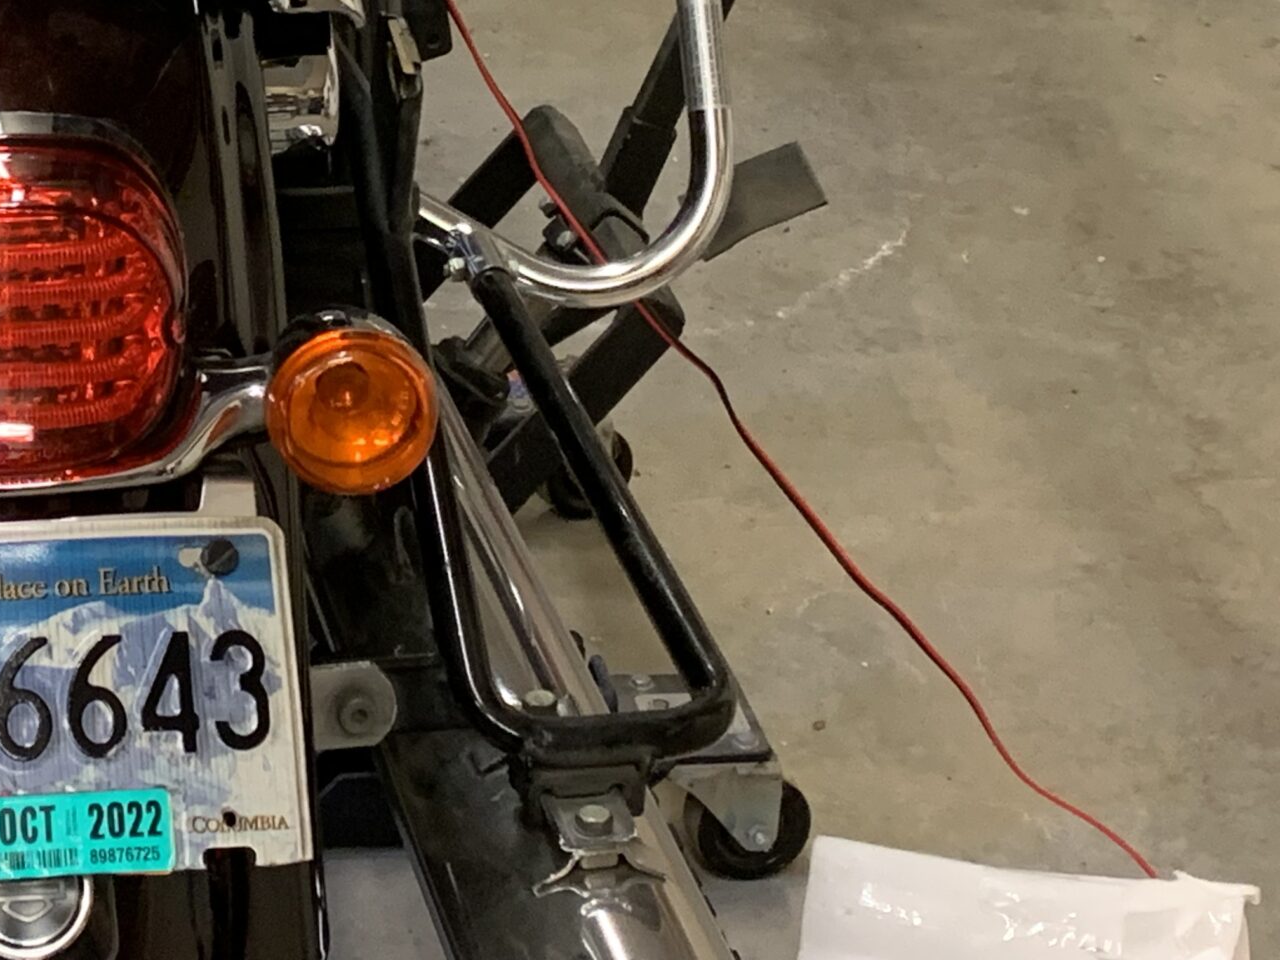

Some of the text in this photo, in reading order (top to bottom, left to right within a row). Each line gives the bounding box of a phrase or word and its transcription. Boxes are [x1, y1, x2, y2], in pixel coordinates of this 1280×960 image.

[55, 577, 90, 597] on
[98, 566, 172, 595] Earth
[87, 800, 163, 840] 2022
